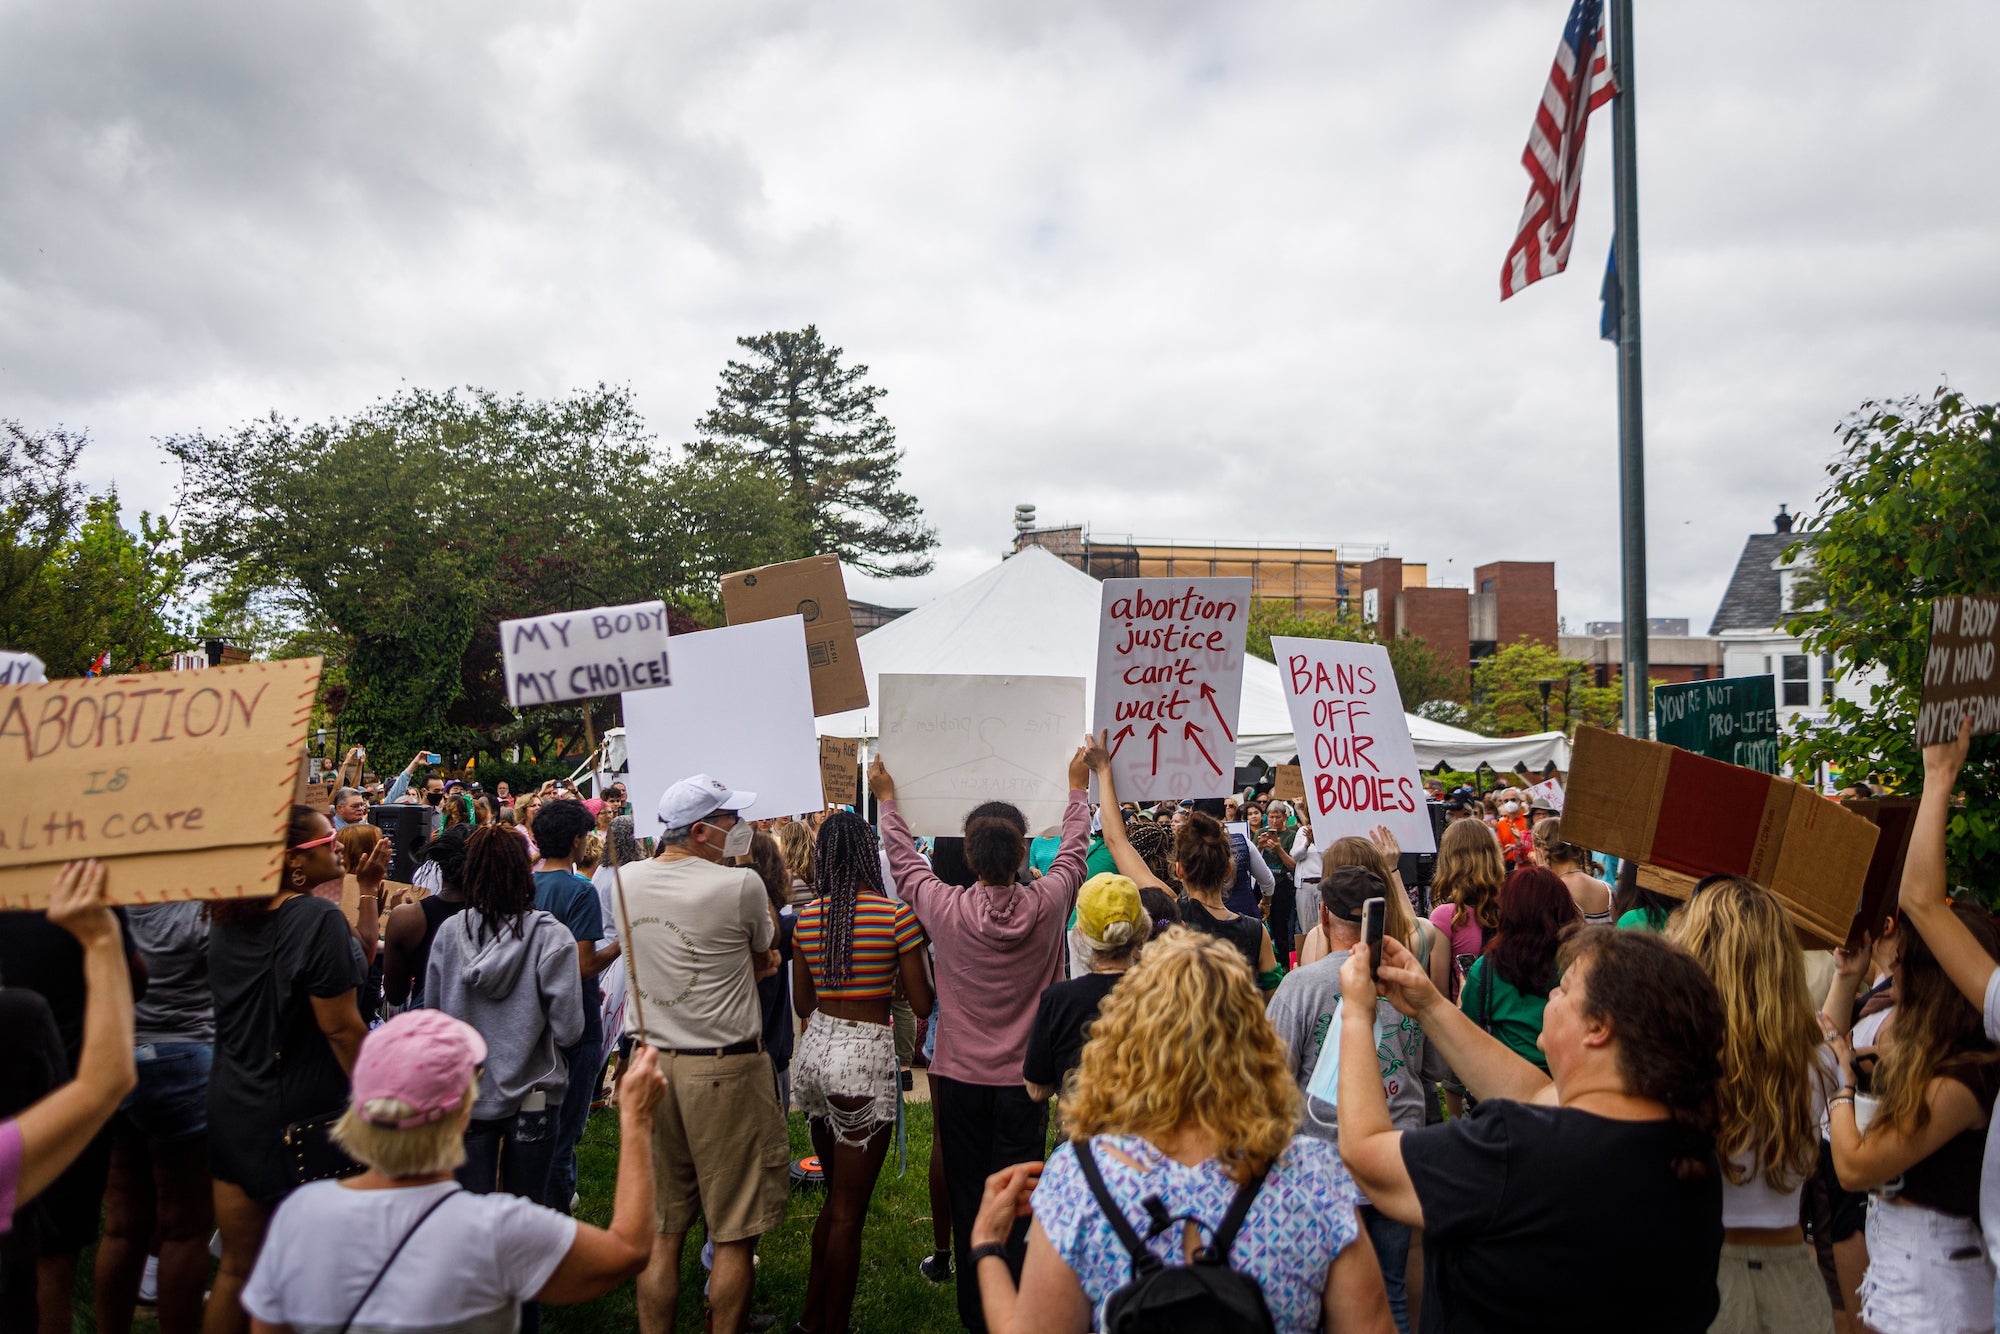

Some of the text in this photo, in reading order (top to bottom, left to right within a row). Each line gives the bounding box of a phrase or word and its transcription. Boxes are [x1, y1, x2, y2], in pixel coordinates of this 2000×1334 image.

[1110, 586, 1237, 622] abortion
[1932, 596, 1999, 637] MY BODY
[512, 609, 663, 654] MY BODY
[1116, 622, 1226, 655] justice
[1123, 658, 1197, 685] can't
[1289, 654, 1377, 696] BANS
[1924, 641, 1995, 686] MY MIND
[516, 669, 557, 704] MY
[0, 682, 270, 762] ABORTION
[1115, 689, 1190, 722] wait
[1313, 699, 1371, 734] OFF
[1658, 685, 1733, 728] YOU'RE NOT
[1708, 708, 1776, 741] PRO-LIFE
[843, 742, 856, 757] ROE
[1314, 733, 1380, 773] OUR
[1314, 774, 1416, 816] BODIES
[102, 807, 205, 839] care
